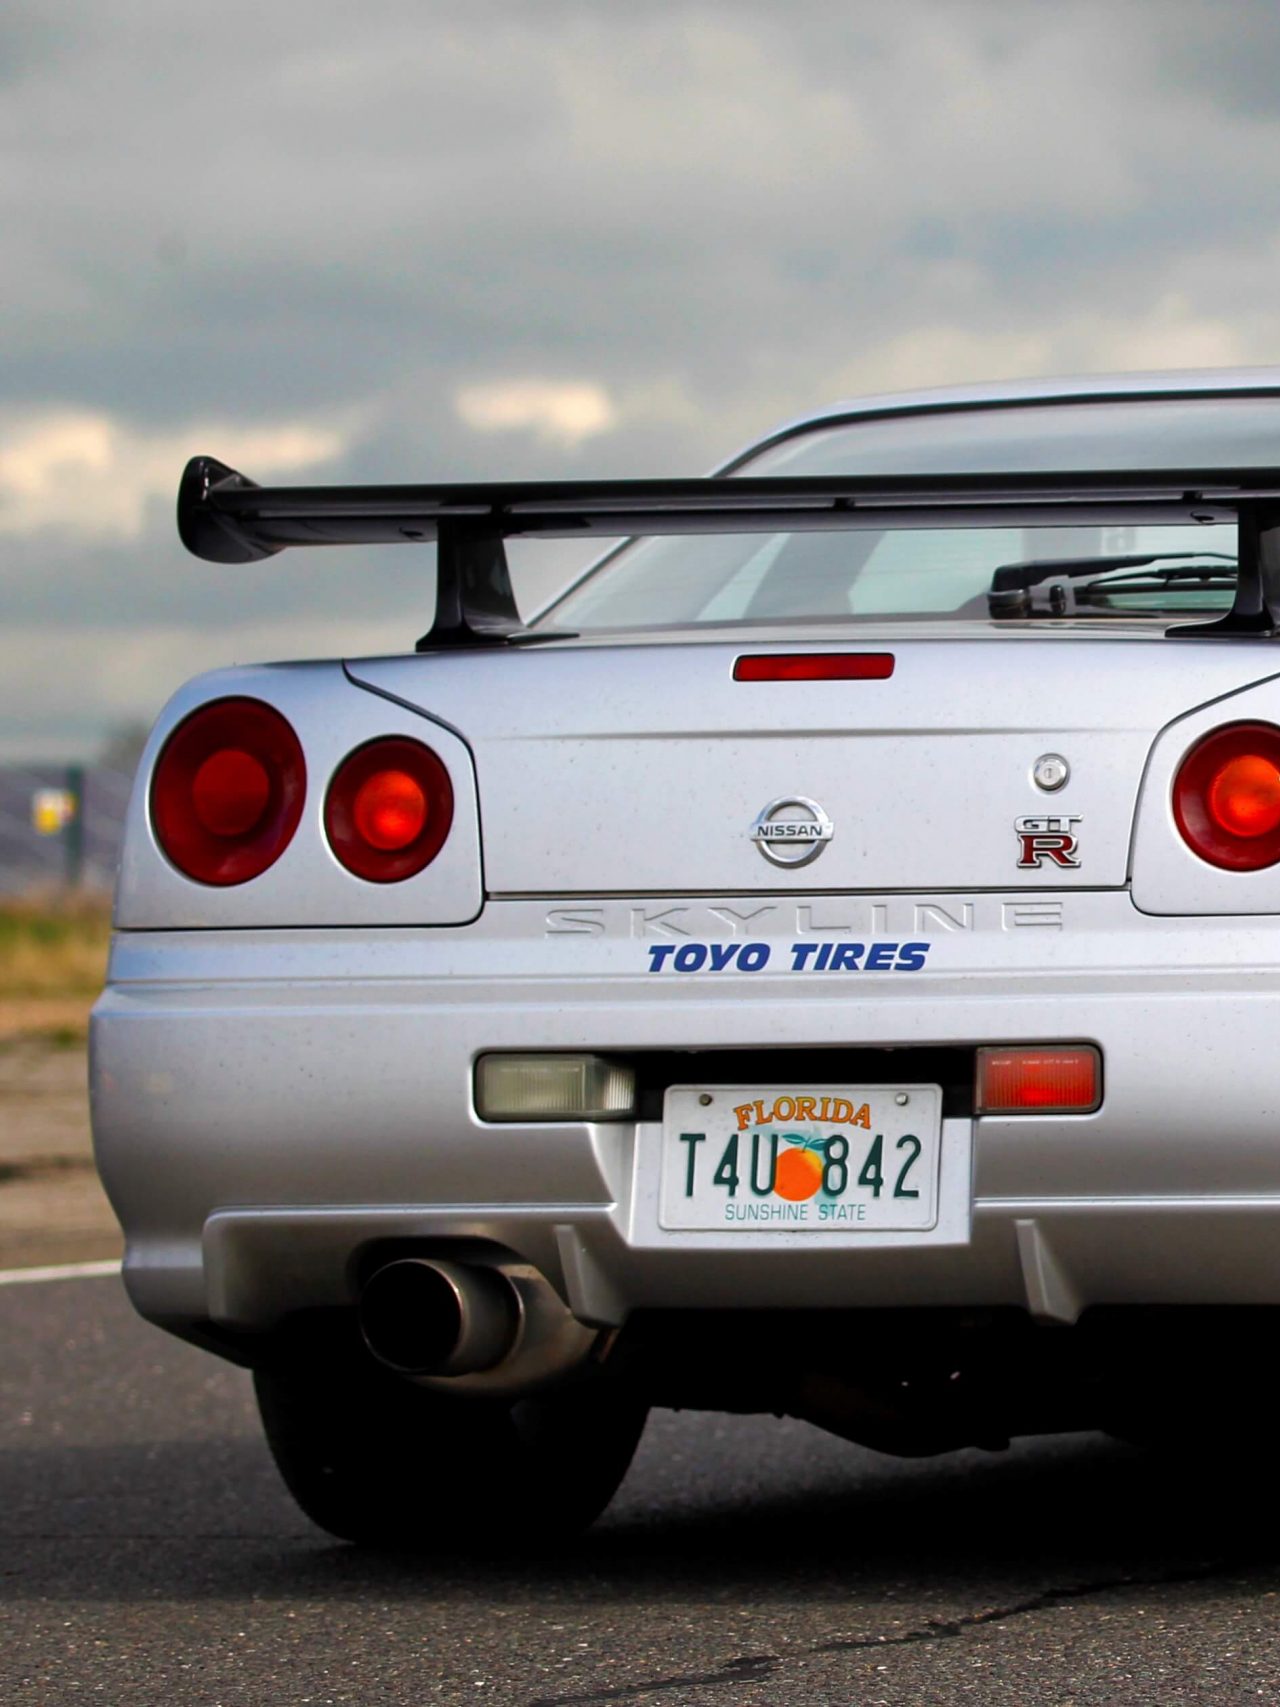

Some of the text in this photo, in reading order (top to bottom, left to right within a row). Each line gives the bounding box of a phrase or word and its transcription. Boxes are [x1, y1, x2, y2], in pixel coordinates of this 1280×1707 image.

[757, 824, 823, 838] NISSAN
[1015, 814, 1083, 834] GT
[1017, 833, 1081, 868] R
[545, 902, 1064, 937] SKYLINE
[648, 942, 930, 972] TOYO TIRES
[733, 1096, 871, 1131] FLORIDA
[679, 1133, 922, 1198] T4U 842
[725, 1203, 866, 1221] SUNSHINE STATE
